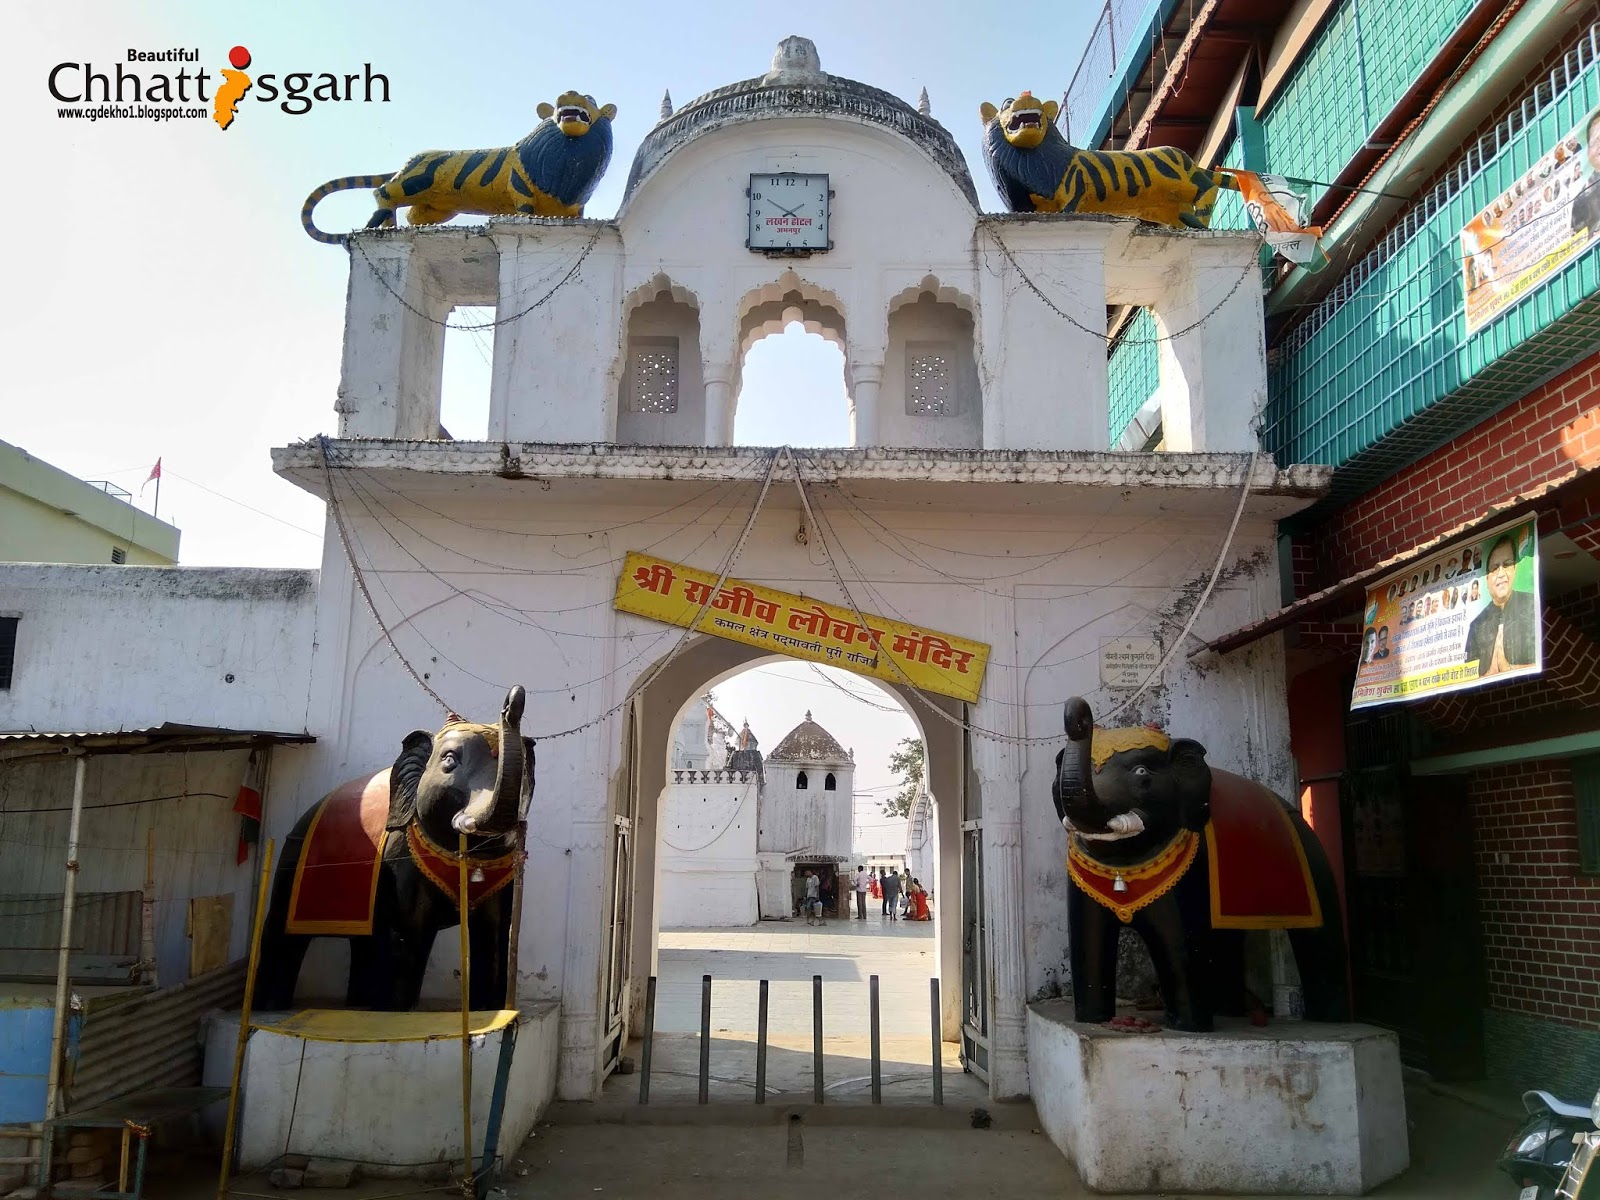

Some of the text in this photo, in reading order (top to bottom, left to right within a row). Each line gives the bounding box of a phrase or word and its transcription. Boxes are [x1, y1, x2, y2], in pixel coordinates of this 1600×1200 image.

[752, 193, 762, 201] 10
[818, 194, 824, 202] 2
[755, 224, 761, 232] 8
[631, 563, 976, 675] श्री राजीव लोचन मंदिर
[714, 616, 747, 633] कमल
[749, 625, 770, 641] क्षेत्र
[825, 646, 843, 660] पुरी
